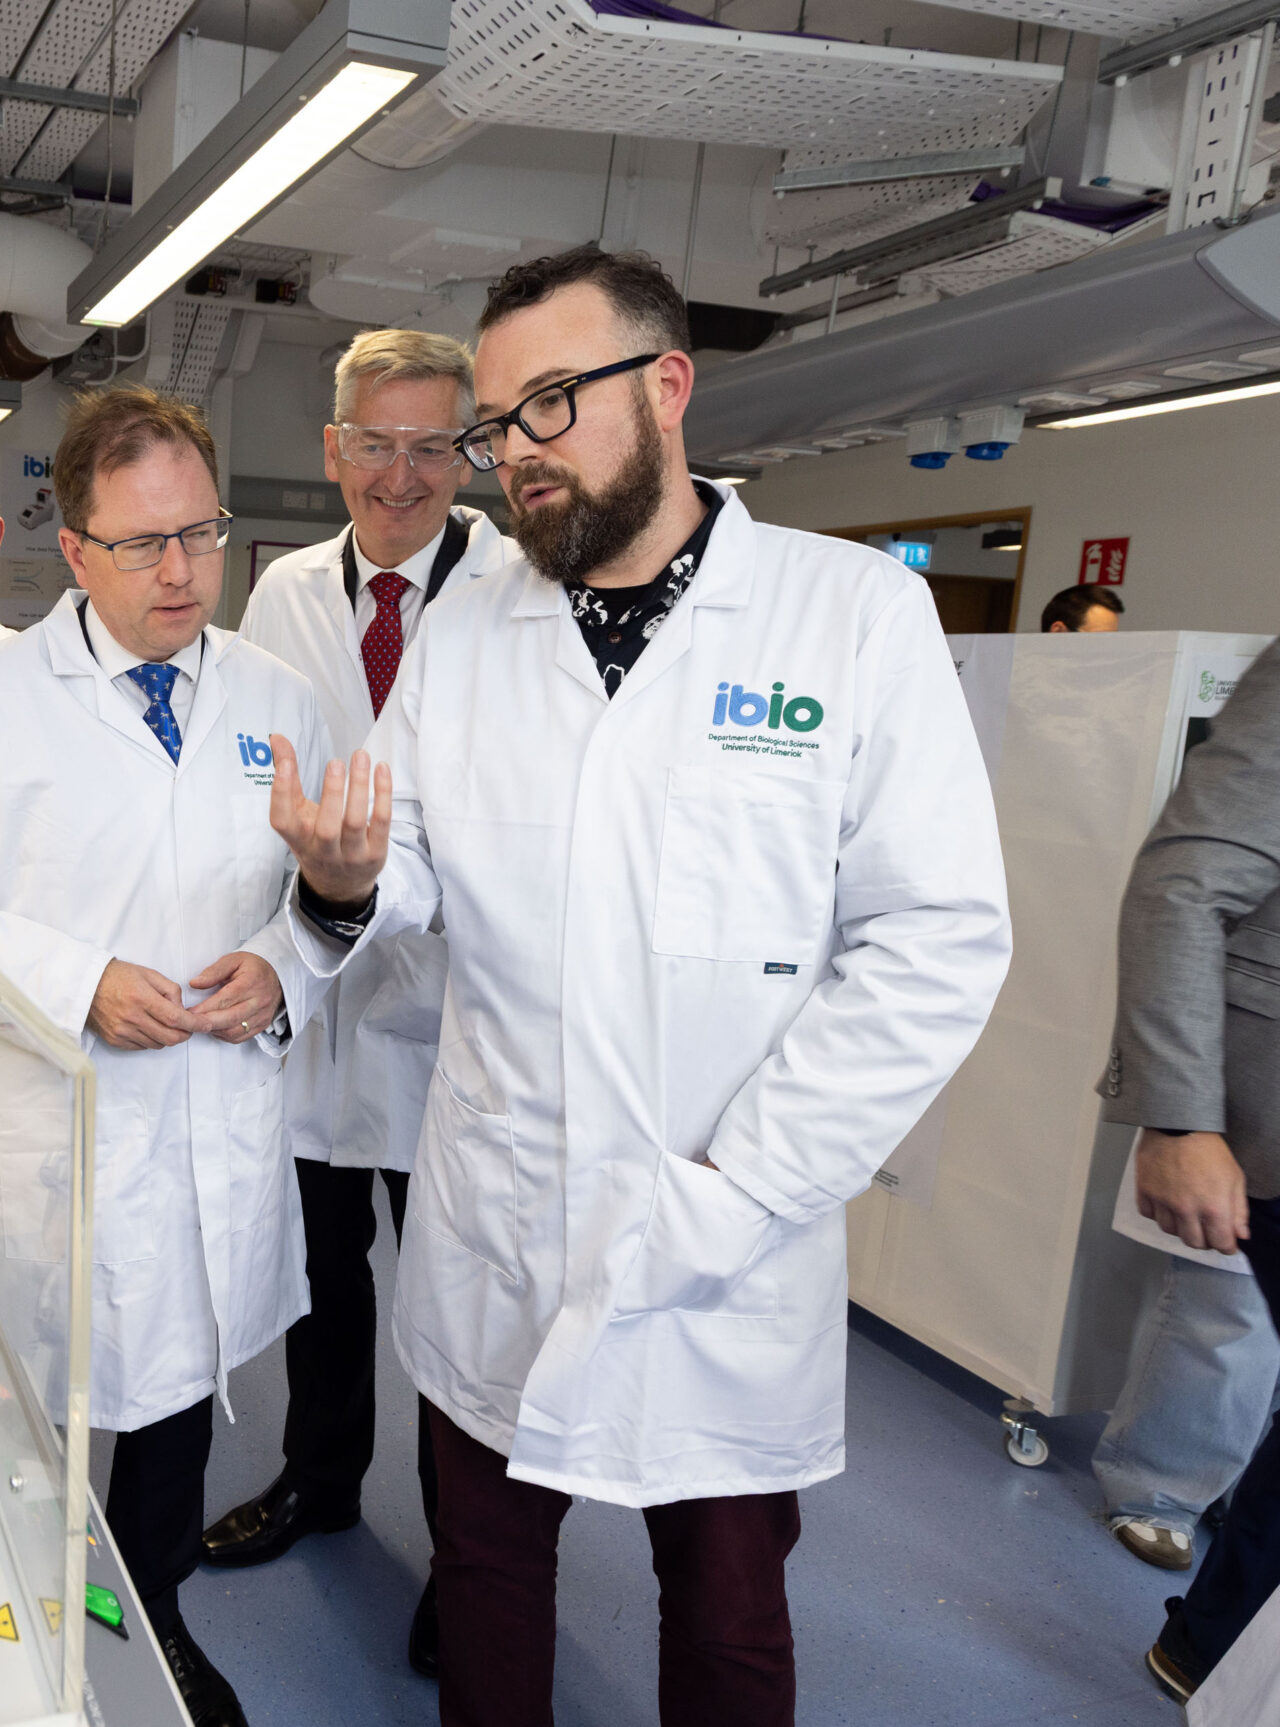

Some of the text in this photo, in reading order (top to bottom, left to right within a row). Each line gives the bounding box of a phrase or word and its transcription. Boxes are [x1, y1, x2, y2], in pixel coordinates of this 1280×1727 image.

[24, 455, 55, 478] ibi
[712, 681, 825, 733] ibio
[237, 733, 276, 768] ib
[708, 733, 748, 742] Department
[757, 735, 788, 747] Biological
[789, 740, 820, 750] Sciences
[722, 743, 761, 754] University
[770, 747, 802, 758] Limerick
